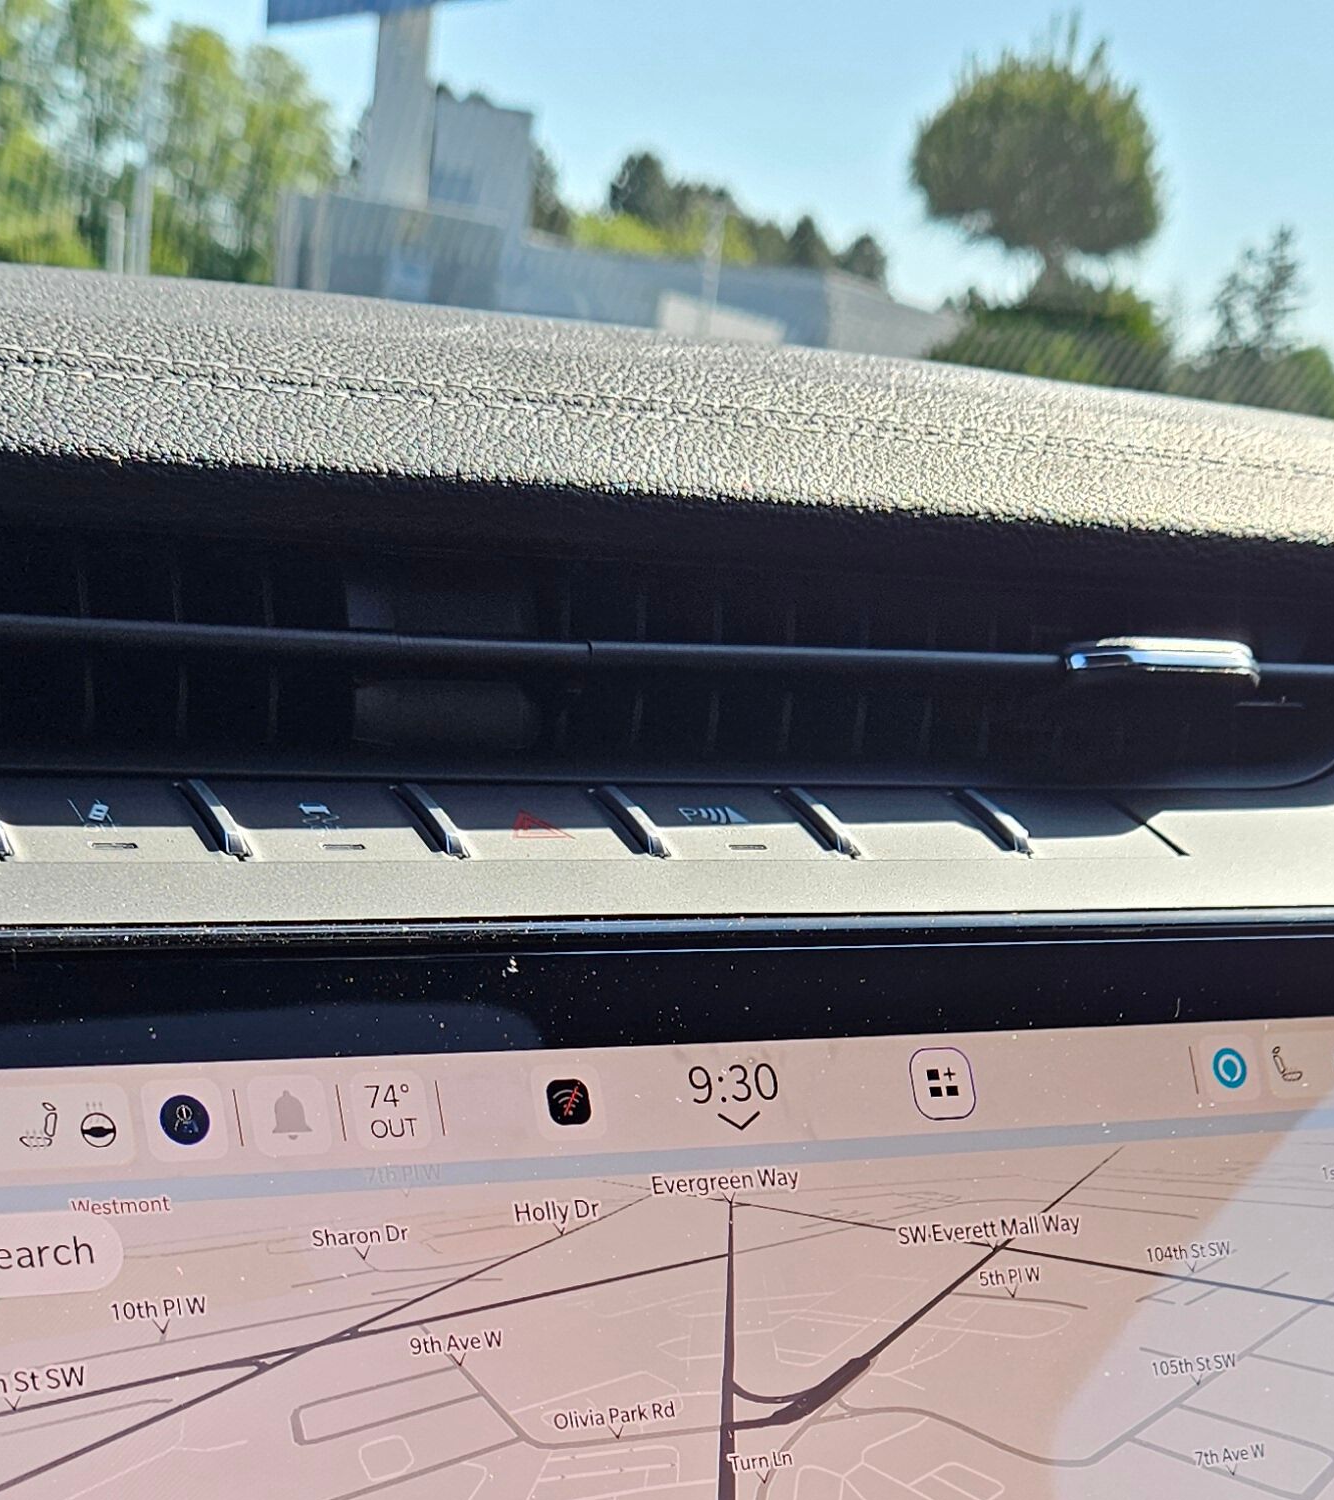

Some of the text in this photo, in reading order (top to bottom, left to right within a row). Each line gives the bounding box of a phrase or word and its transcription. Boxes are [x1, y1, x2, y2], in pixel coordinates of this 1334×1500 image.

[687, 1062, 779, 1105] 9:30
[370, 1117, 418, 1139] OUT
[650, 1168, 800, 1198] Evergreen Way
[70, 1196, 171, 1216] Westmont
[513, 1199, 601, 1227] Holly Dr
[311, 1224, 409, 1249] Sharon Dr
[897, 1214, 1081, 1246] SW Everett Mall Way
[1146, 1240, 1231, 1263] 104th St SW
[979, 1269, 1007, 1288] 5th
[1024, 1266, 1041, 1283] W
[110, 1296, 207, 1321] 10th Pl W
[409, 1330, 503, 1356] 9th Ave W
[1152, 1354, 1237, 1377] 105th St SW
[13, 1370, 40, 1393] St
[45, 1366, 86, 1389] SW
[553, 1401, 676, 1431] Olivia Park Rd
[728, 1450, 793, 1473] Turn Ln
[1194, 1444, 1266, 1467] 7th Ave W
